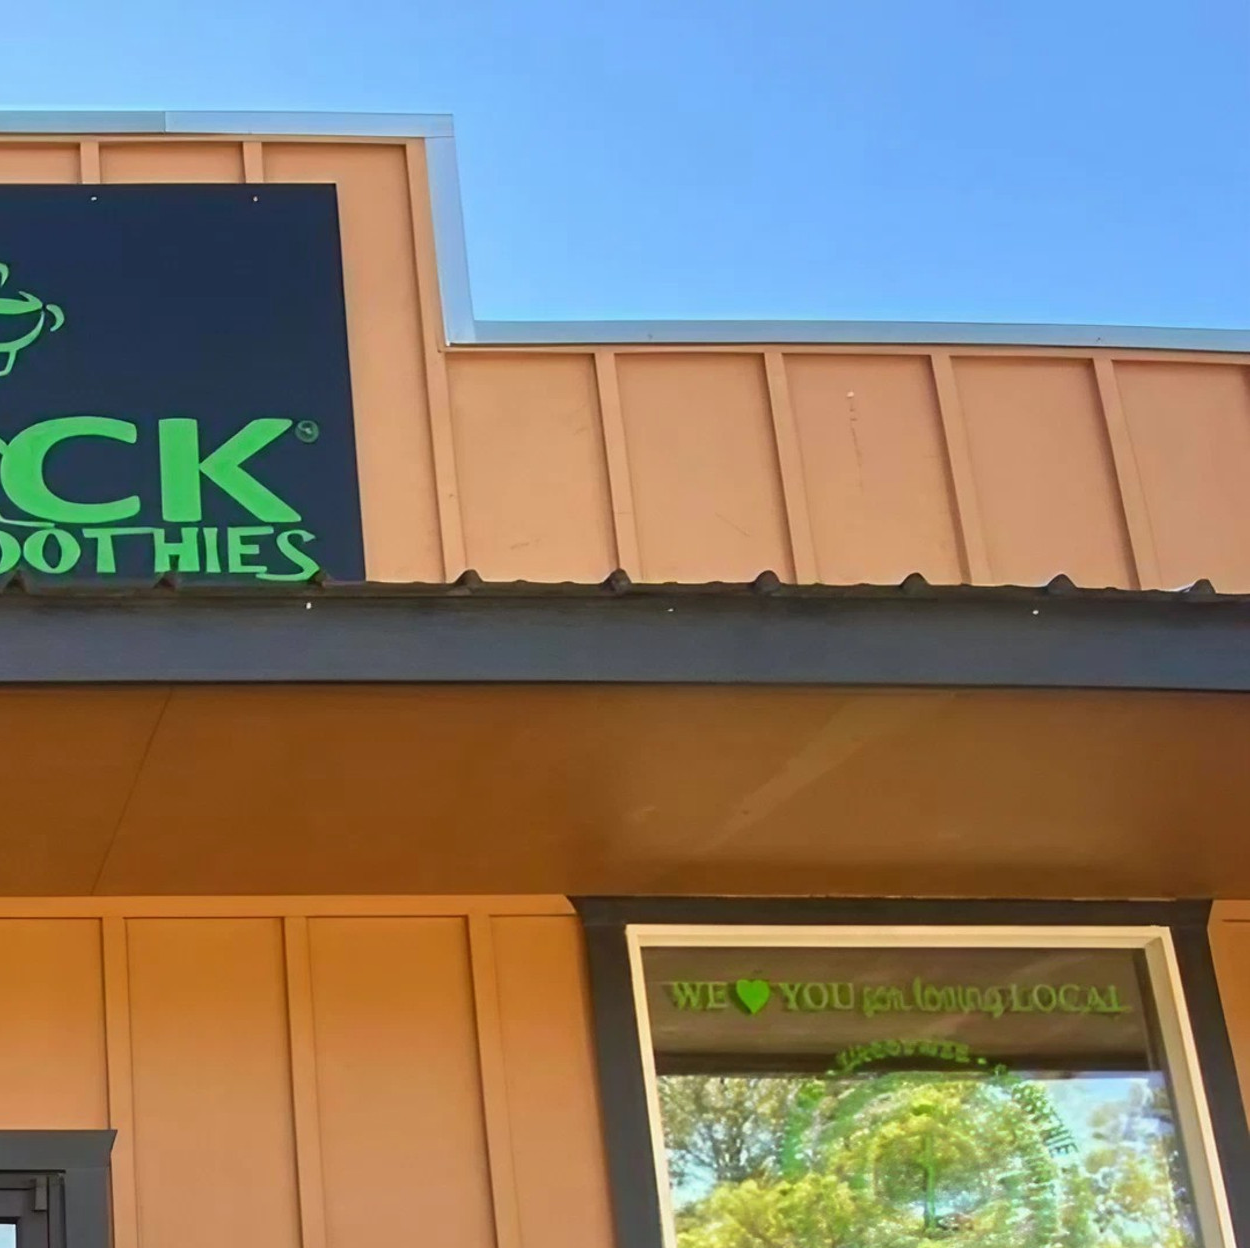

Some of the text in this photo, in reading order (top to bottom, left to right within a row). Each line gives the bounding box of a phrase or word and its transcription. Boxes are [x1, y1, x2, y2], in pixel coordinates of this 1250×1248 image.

[671, 981, 730, 1010] WE
[778, 982, 855, 1011] YOU
[1006, 983, 1133, 1014] LOCAL
